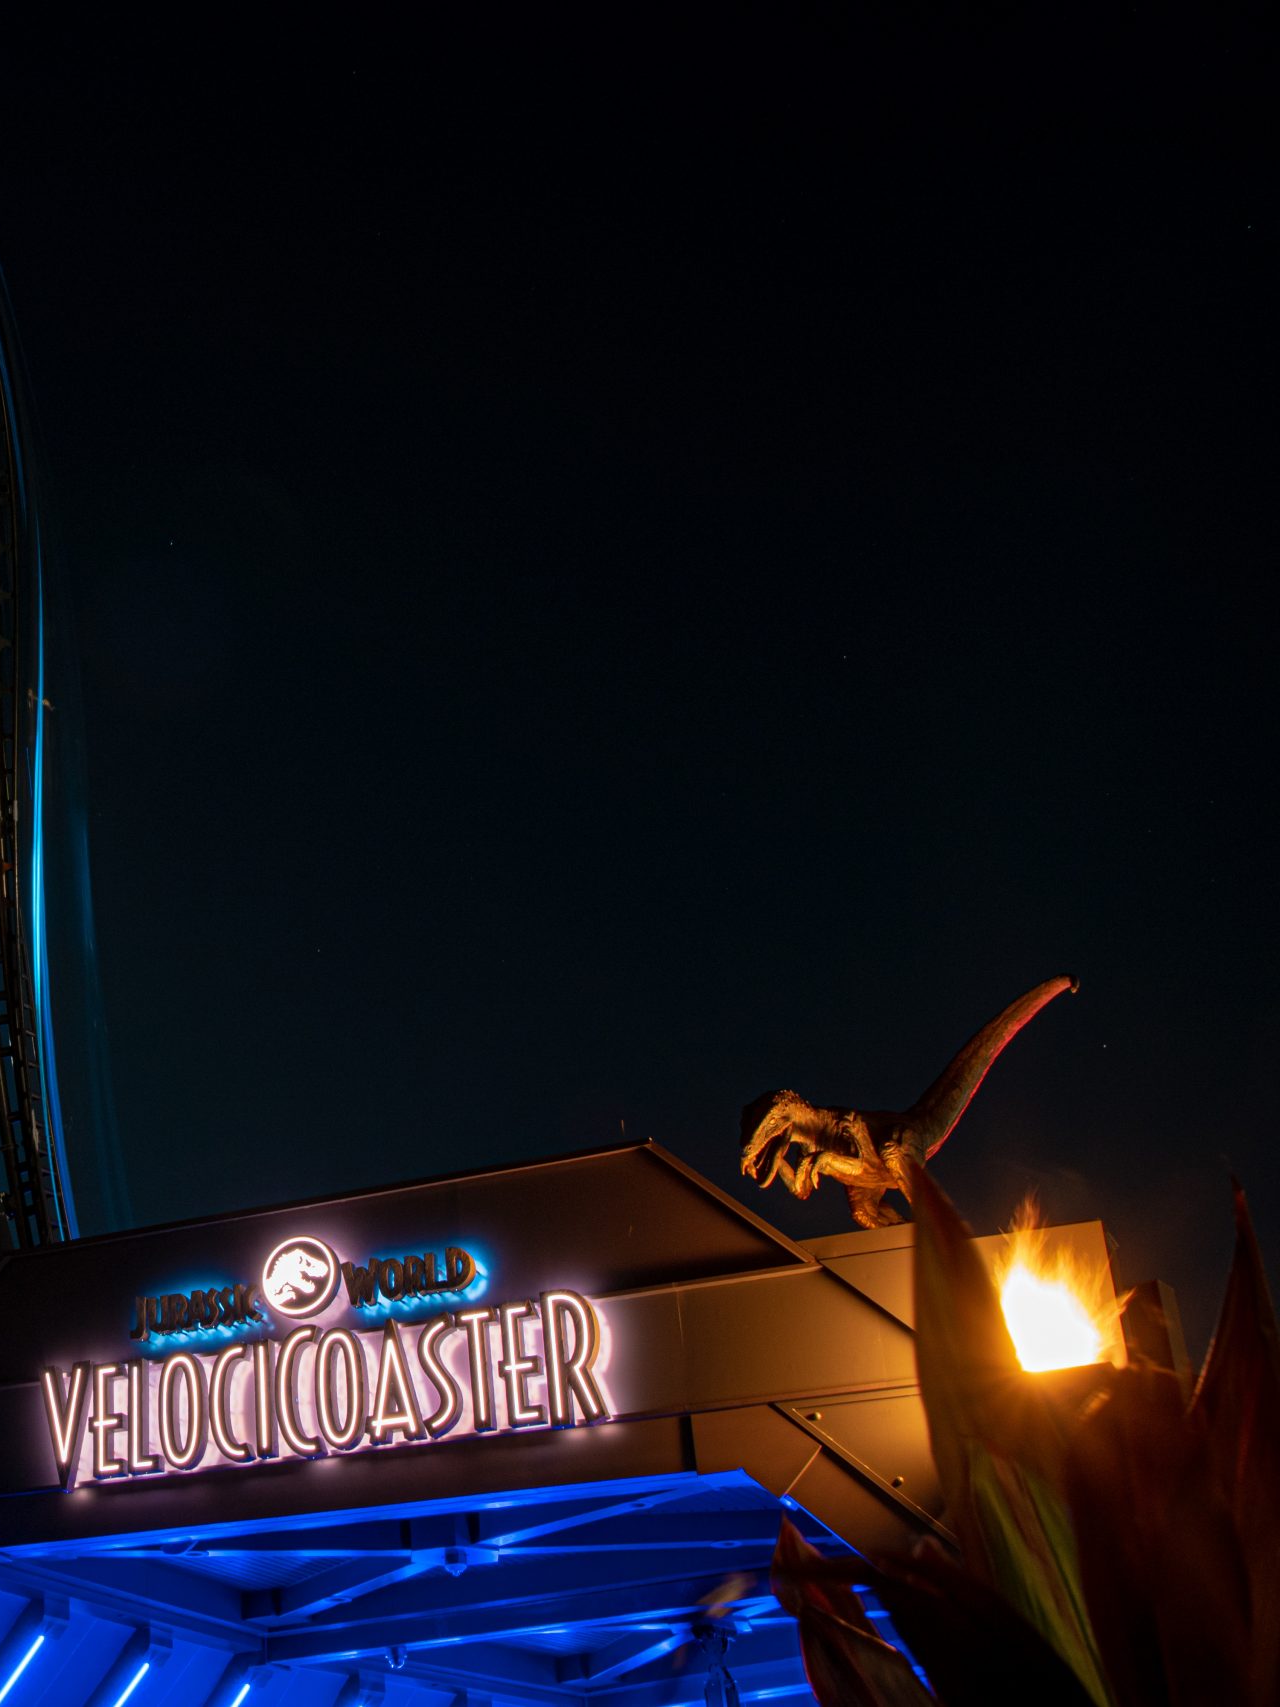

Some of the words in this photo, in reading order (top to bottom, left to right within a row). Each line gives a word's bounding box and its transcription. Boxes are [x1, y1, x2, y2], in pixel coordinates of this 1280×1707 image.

[130, 1283, 263, 1341] JURASSIC
[341, 1246, 477, 1308] WORLD
[40, 1290, 610, 1493] VELOCICOASTER
